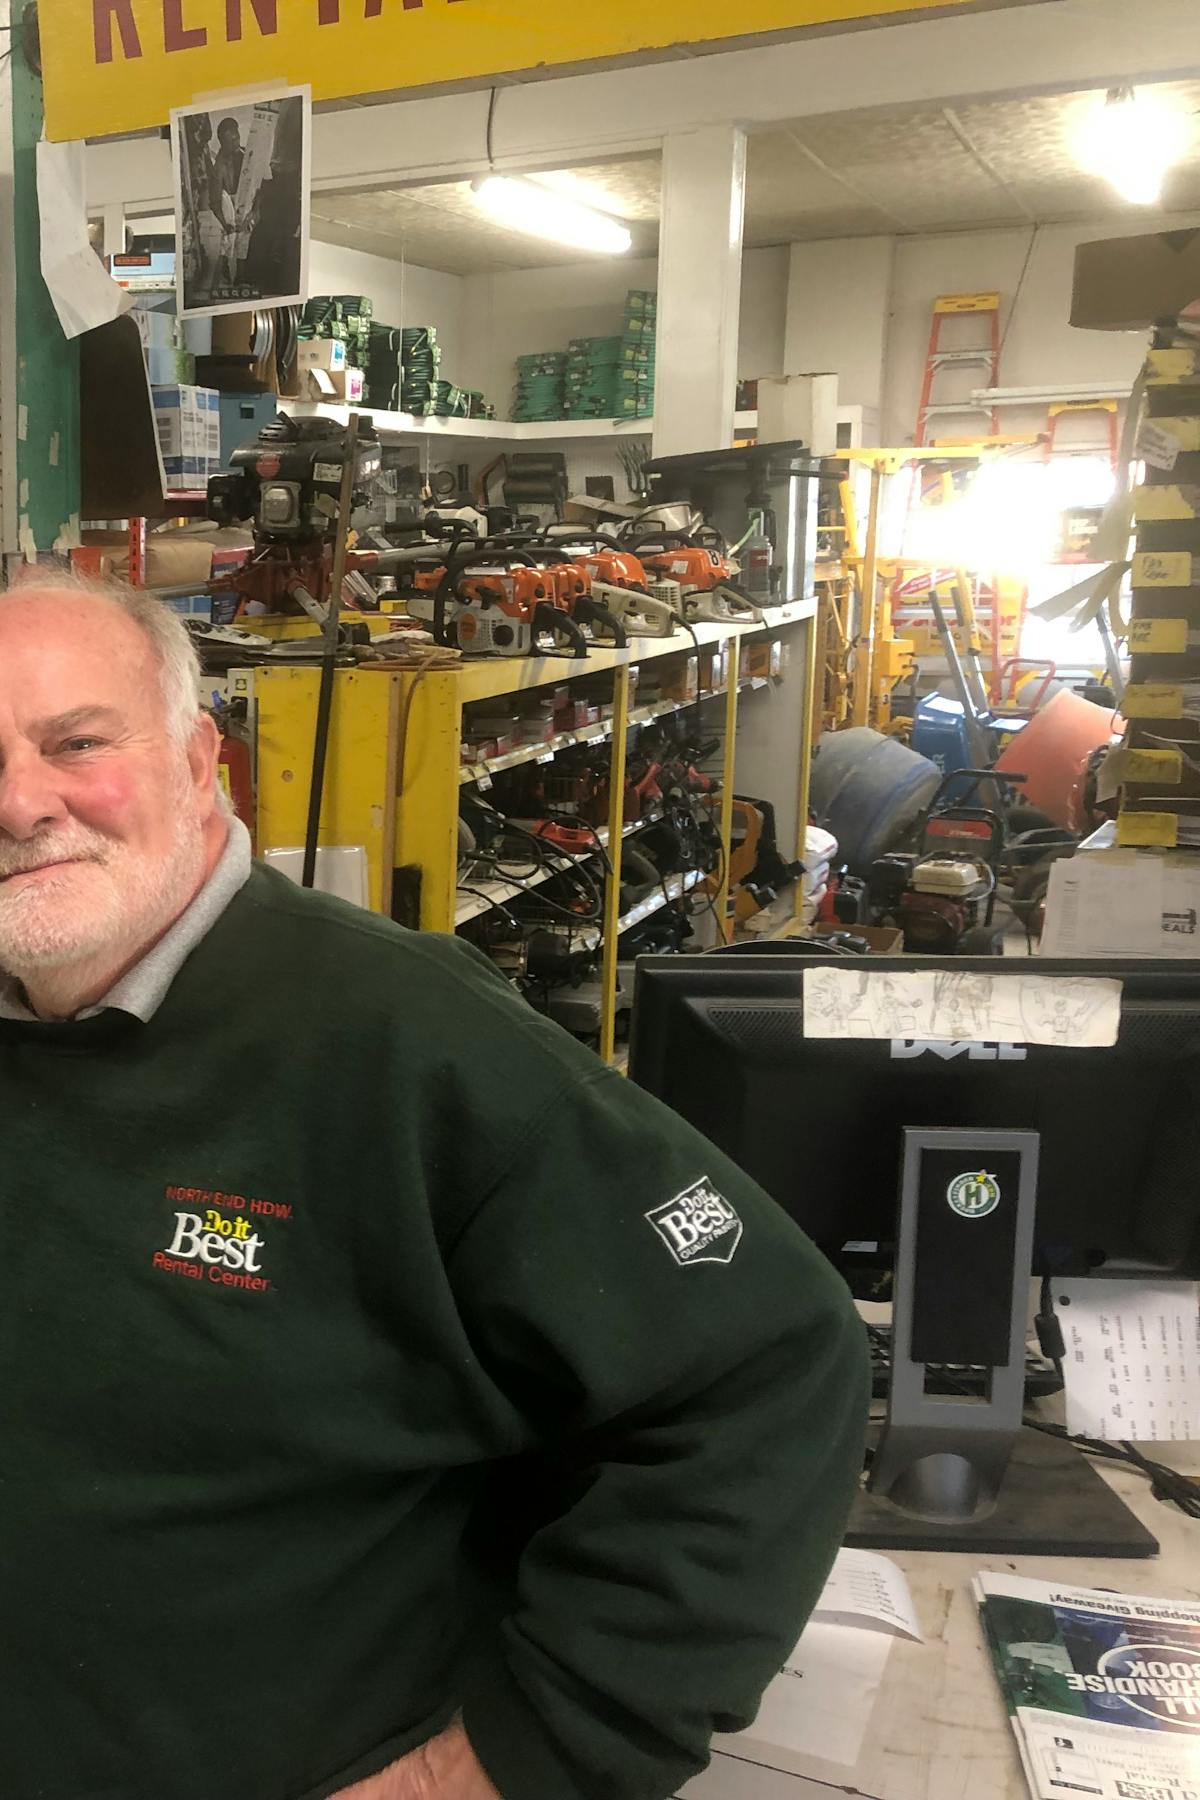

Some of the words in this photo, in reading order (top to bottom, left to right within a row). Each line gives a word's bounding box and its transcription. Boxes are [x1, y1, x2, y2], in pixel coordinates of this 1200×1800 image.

[165, 1186, 210, 1201] NORTH
[214, 1192, 246, 1209] END
[679, 1196, 703, 1217] Do
[202, 1209, 232, 1236] Do
[233, 1216, 252, 1239] it
[658, 1192, 733, 1252] Best
[164, 1212, 265, 1272] Best
[153, 1252, 204, 1280] Rental
[208, 1266, 272, 1291] Center
[1049, 1593, 1131, 1615] Giveaway!
